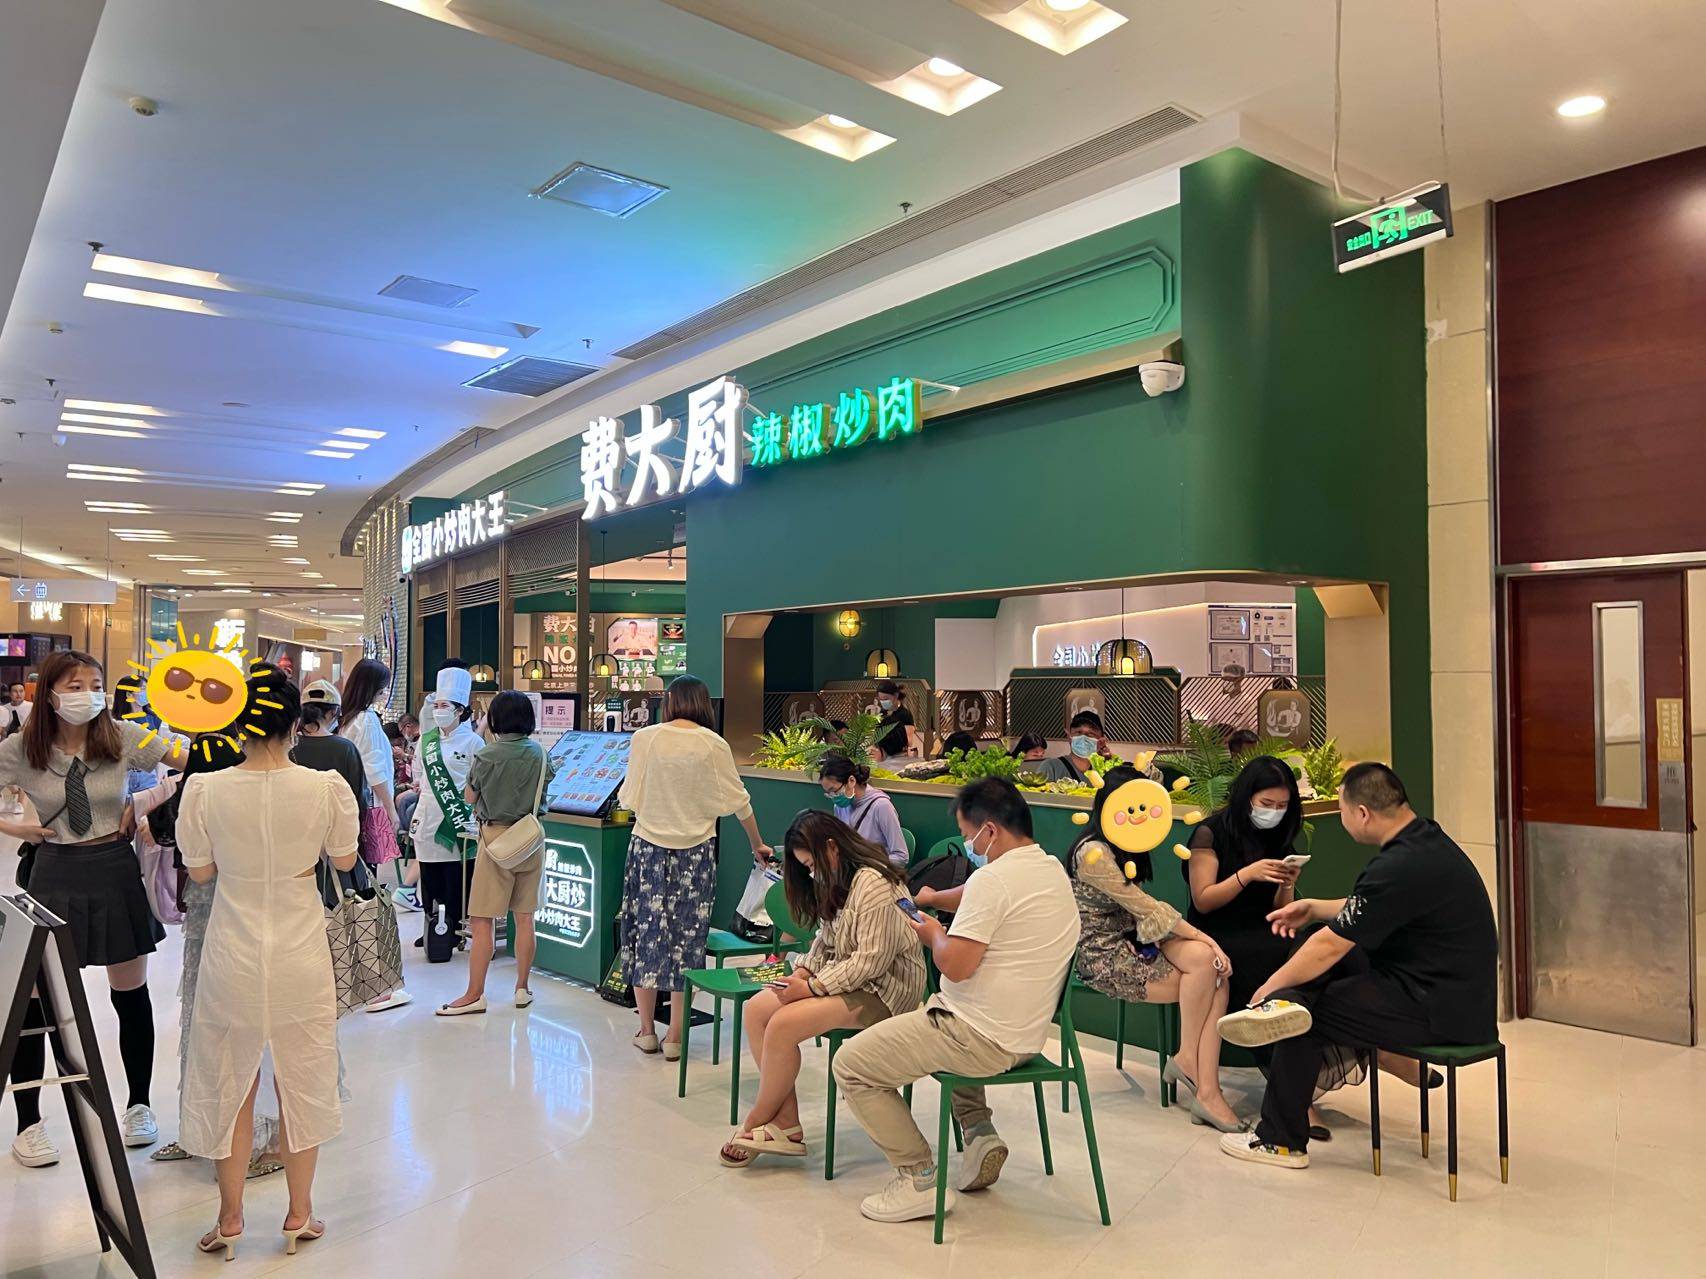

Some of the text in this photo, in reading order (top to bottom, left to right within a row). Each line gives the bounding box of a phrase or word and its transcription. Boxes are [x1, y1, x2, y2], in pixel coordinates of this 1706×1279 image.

[1407, 209, 1434, 231] EXIT
[581, 375, 746, 520] 费大厨
[750, 377, 917, 467] 辣椒炒肉
[426, 741, 467, 830] 全国小炒肉大王
